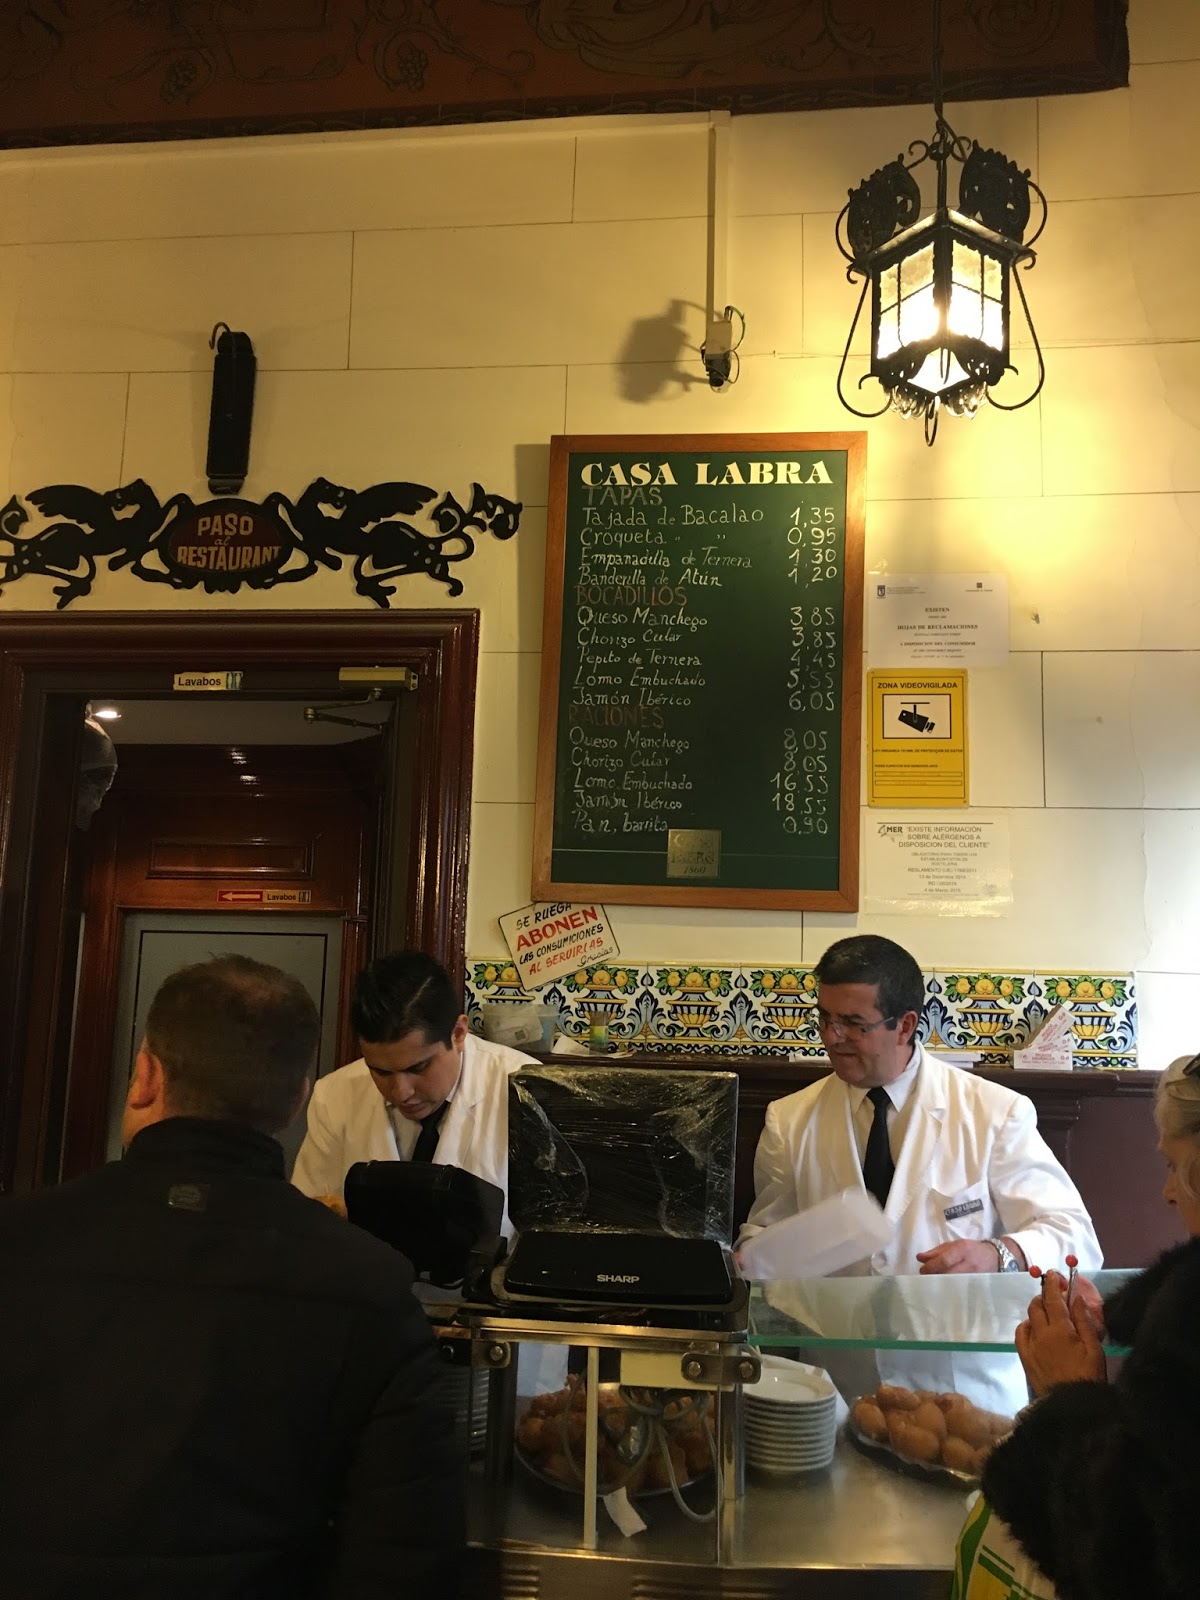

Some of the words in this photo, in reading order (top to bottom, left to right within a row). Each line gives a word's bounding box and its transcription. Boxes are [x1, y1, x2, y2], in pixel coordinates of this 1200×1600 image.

[581, 462, 678, 487] CASA
[695, 460, 834, 486] LABRA
[581, 486, 663, 506] TAPAS
[198, 513, 254, 536] PASO
[657, 506, 676, 526] de
[680, 503, 764, 525] Bacalao
[790, 507, 835, 528] 1,35
[214, 536, 230, 546] al
[580, 527, 667, 548] Croqueta
[787, 527, 836, 548] 0,95
[177, 546, 281, 570] RESTAURANT
[581, 547, 671, 571] Empanadilla
[681, 550, 697, 566] de
[702, 546, 753, 568] Ternera
[578, 566, 646, 586] Banderilla
[655, 570, 669, 585] de
[678, 567, 723, 587] Atún
[574, 585, 688, 606] BOCADILLOS
[577, 605, 629, 626] Queso
[632, 606, 708, 632] Manchego
[577, 627, 636, 648] Chorizo
[642, 627, 682, 643] Cular
[577, 646, 621, 674] Pepito
[628, 652, 643, 665] de
[646, 648, 703, 666] Ternera
[178, 677, 222, 687] Lavabos
[575, 665, 622, 687] Lomo
[787, 668, 834, 690] 5,55
[573, 686, 630, 706] Jamón
[639, 687, 691, 706] Ibérico
[788, 691, 835, 711] 6,05
[625, 729, 690, 754] Manchego
[571, 746, 624, 772] Chorizo
[622, 770, 693, 790] Embuchado
[622, 812, 668, 832] barrita
[933, 825, 982, 833] INFORMACIÓN
[267, 893, 297, 901] Lavabos
[516, 915, 531, 930] SE
[534, 902, 573, 924] RUEGA
[516, 906, 598, 951] ABONEN
[519, 951, 534, 965] LAS
[536, 923, 604, 958] CONSUMICIONES
[529, 962, 542, 976] AL
[596, 1274, 640, 1283] SHARP
